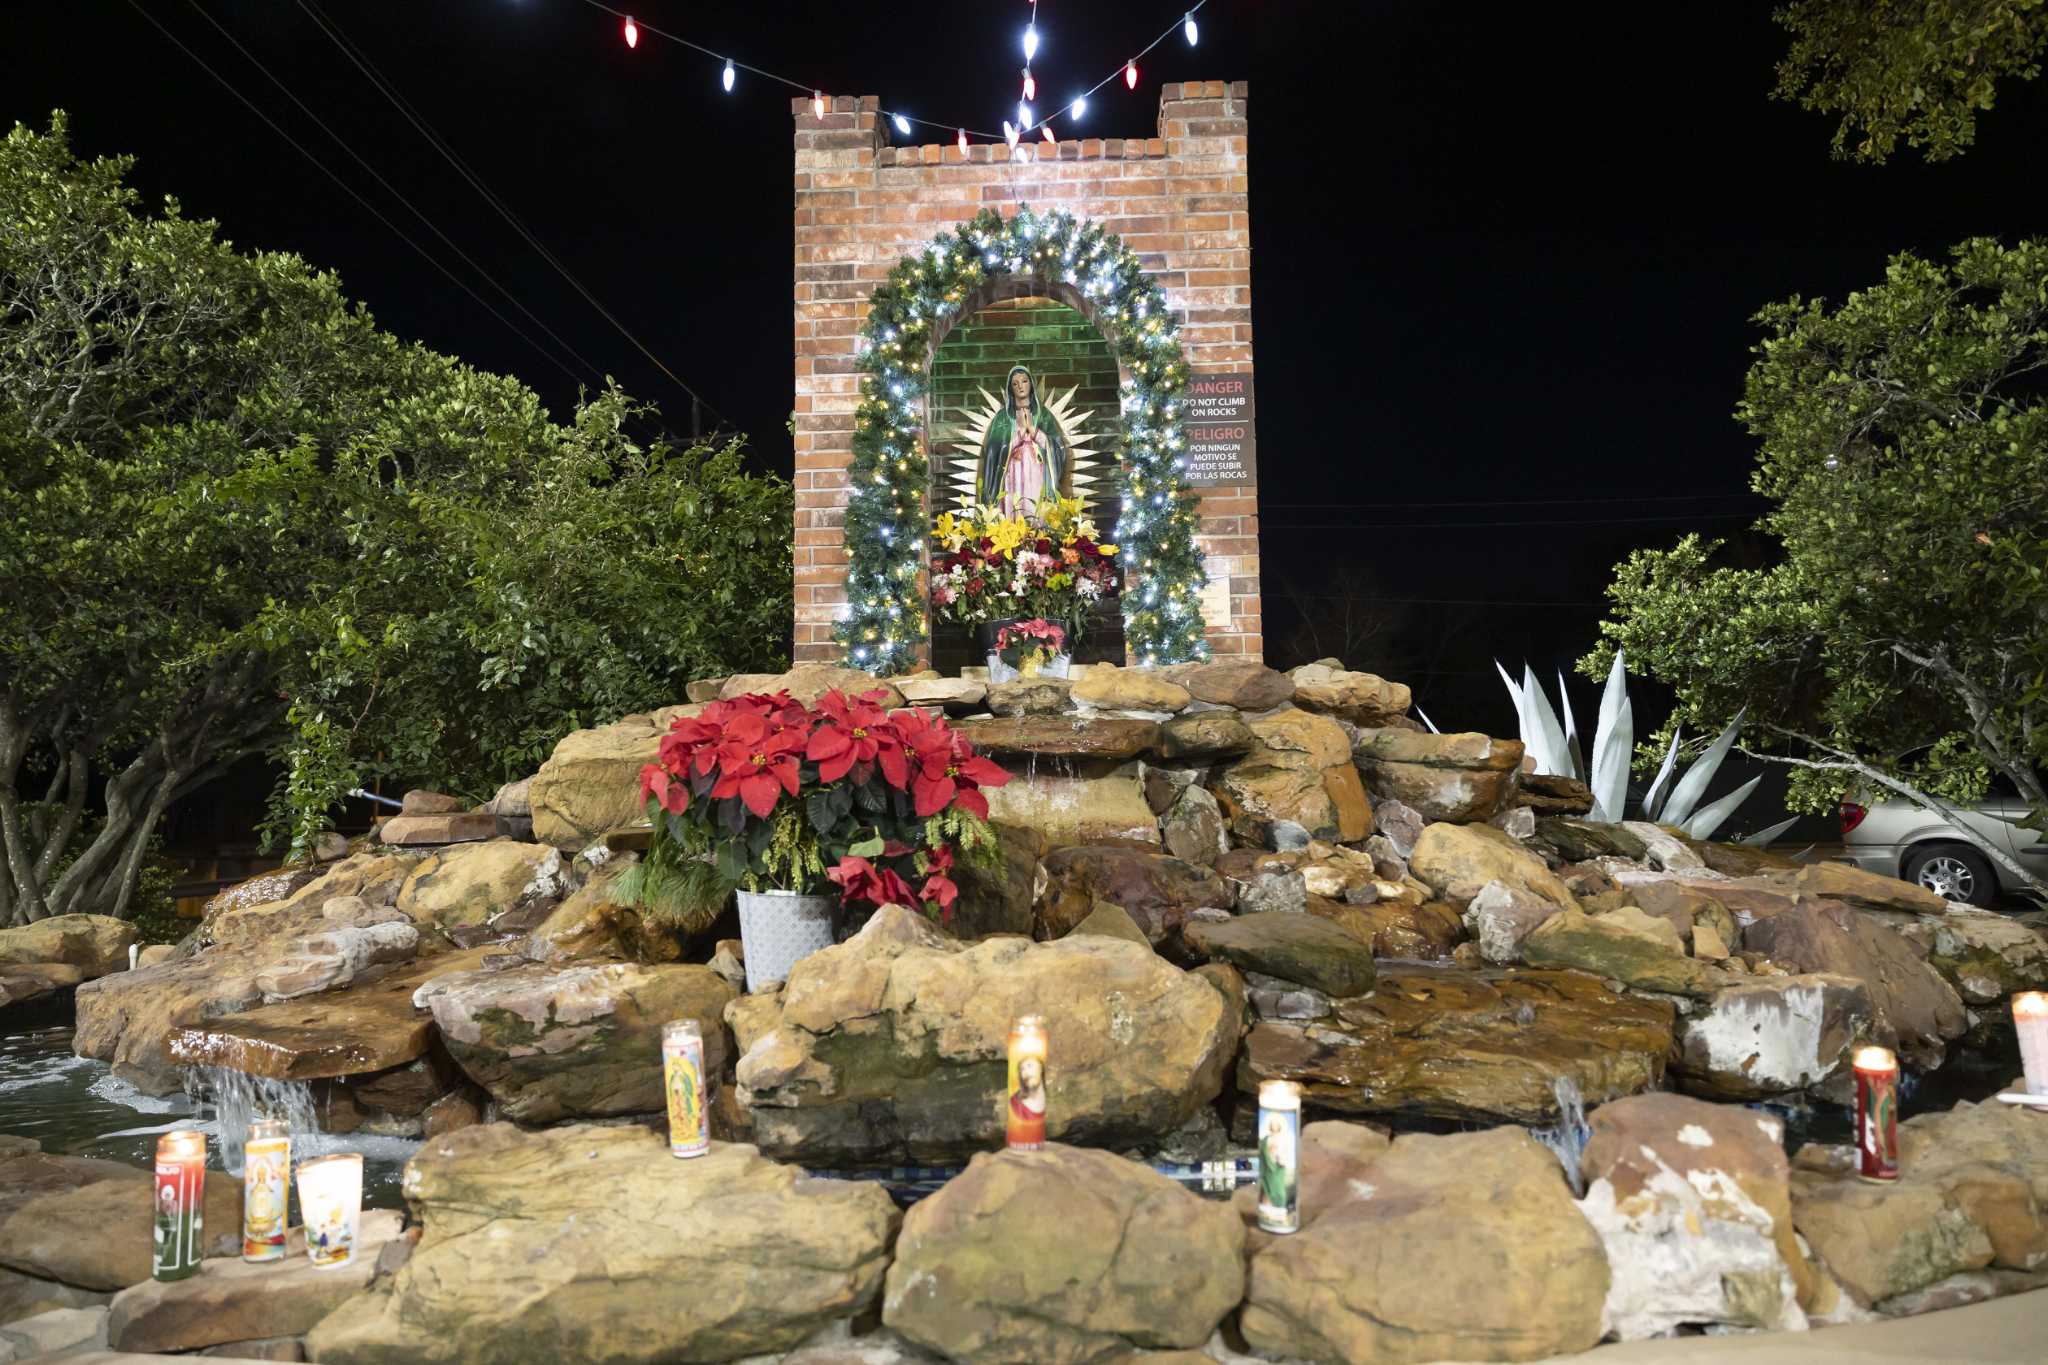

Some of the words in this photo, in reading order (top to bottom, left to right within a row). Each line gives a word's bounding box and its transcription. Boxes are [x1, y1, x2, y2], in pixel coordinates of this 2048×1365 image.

[1183, 399, 1196, 407] DO
[1198, 398, 1217, 407] NOT
[1218, 397, 1246, 406] CLIMB
[1192, 409, 1205, 417] ON
[1207, 407, 1237, 416] ROCKS
[1190, 444, 1207, 452] POR
[1194, 453, 1226, 461] MOTIVO
[1227, 452, 1238, 461] SE
[1190, 462, 1217, 471] PUEDE
[1218, 461, 1242, 470] SUBIR
[1185, 472, 1202, 480] POR
[1203, 471, 1219, 480] LAS
[1219, 470, 1248, 479] ROCAS
